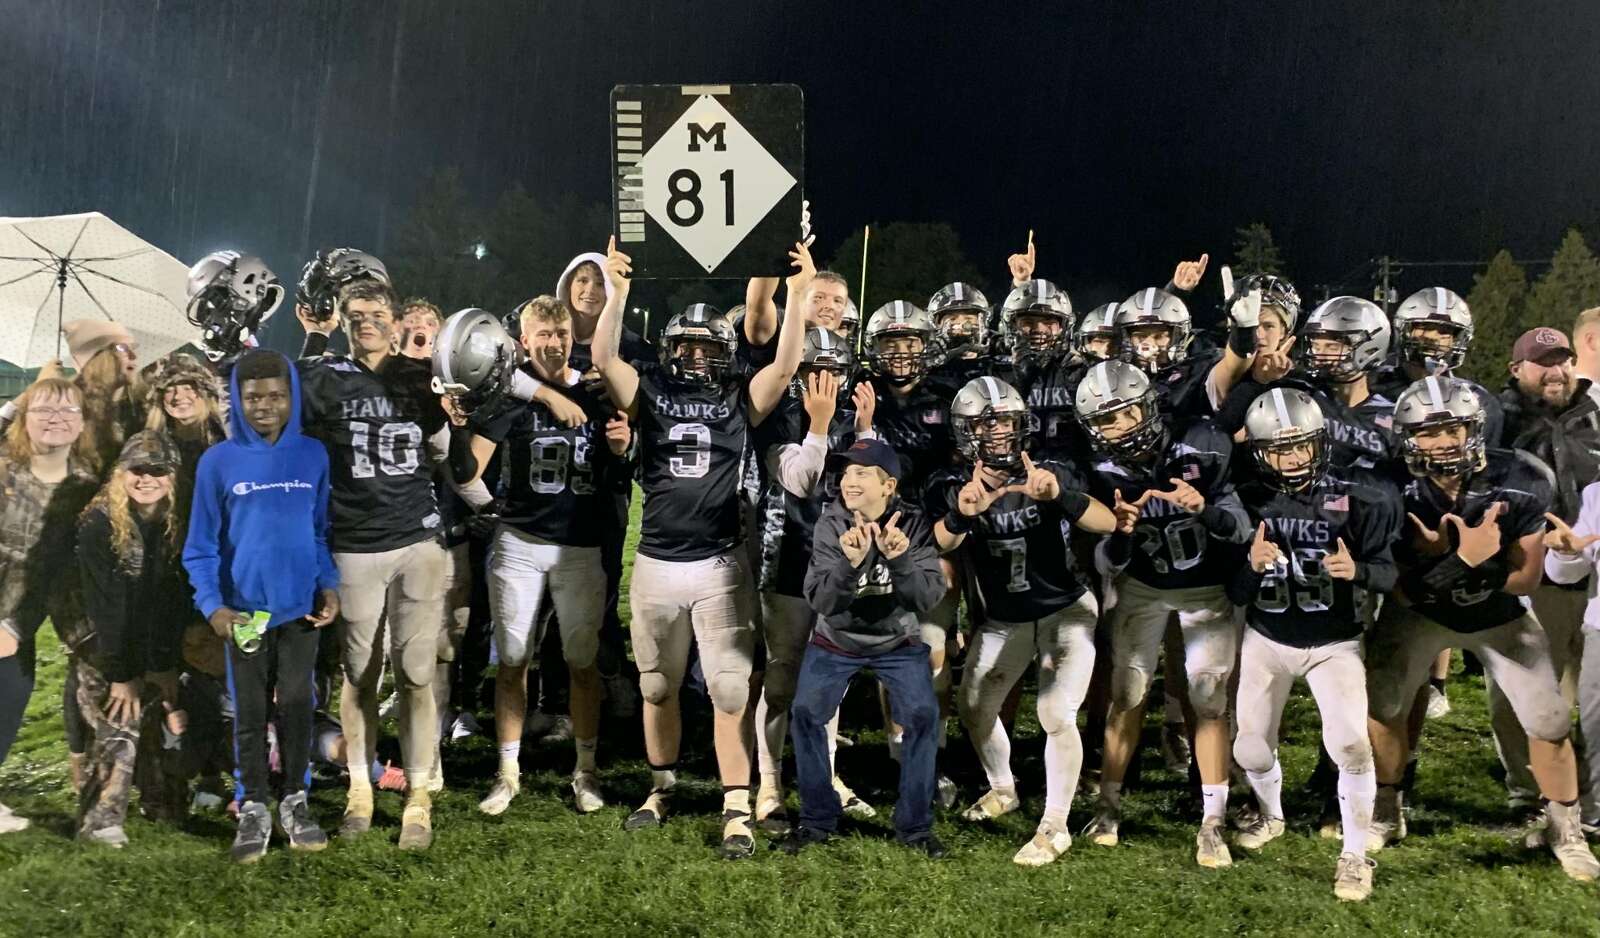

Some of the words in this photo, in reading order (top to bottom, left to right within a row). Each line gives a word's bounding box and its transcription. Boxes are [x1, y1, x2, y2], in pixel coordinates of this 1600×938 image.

[687, 122, 727, 152] M
[666, 168, 735, 227] 81
[340, 396, 404, 420] HAW
[654, 394, 730, 420] HAWKS
[349, 420, 423, 479] 10
[667, 422, 712, 478] 3
[232, 479, 313, 496] Champion
[1263, 517, 1329, 543] AWKS
